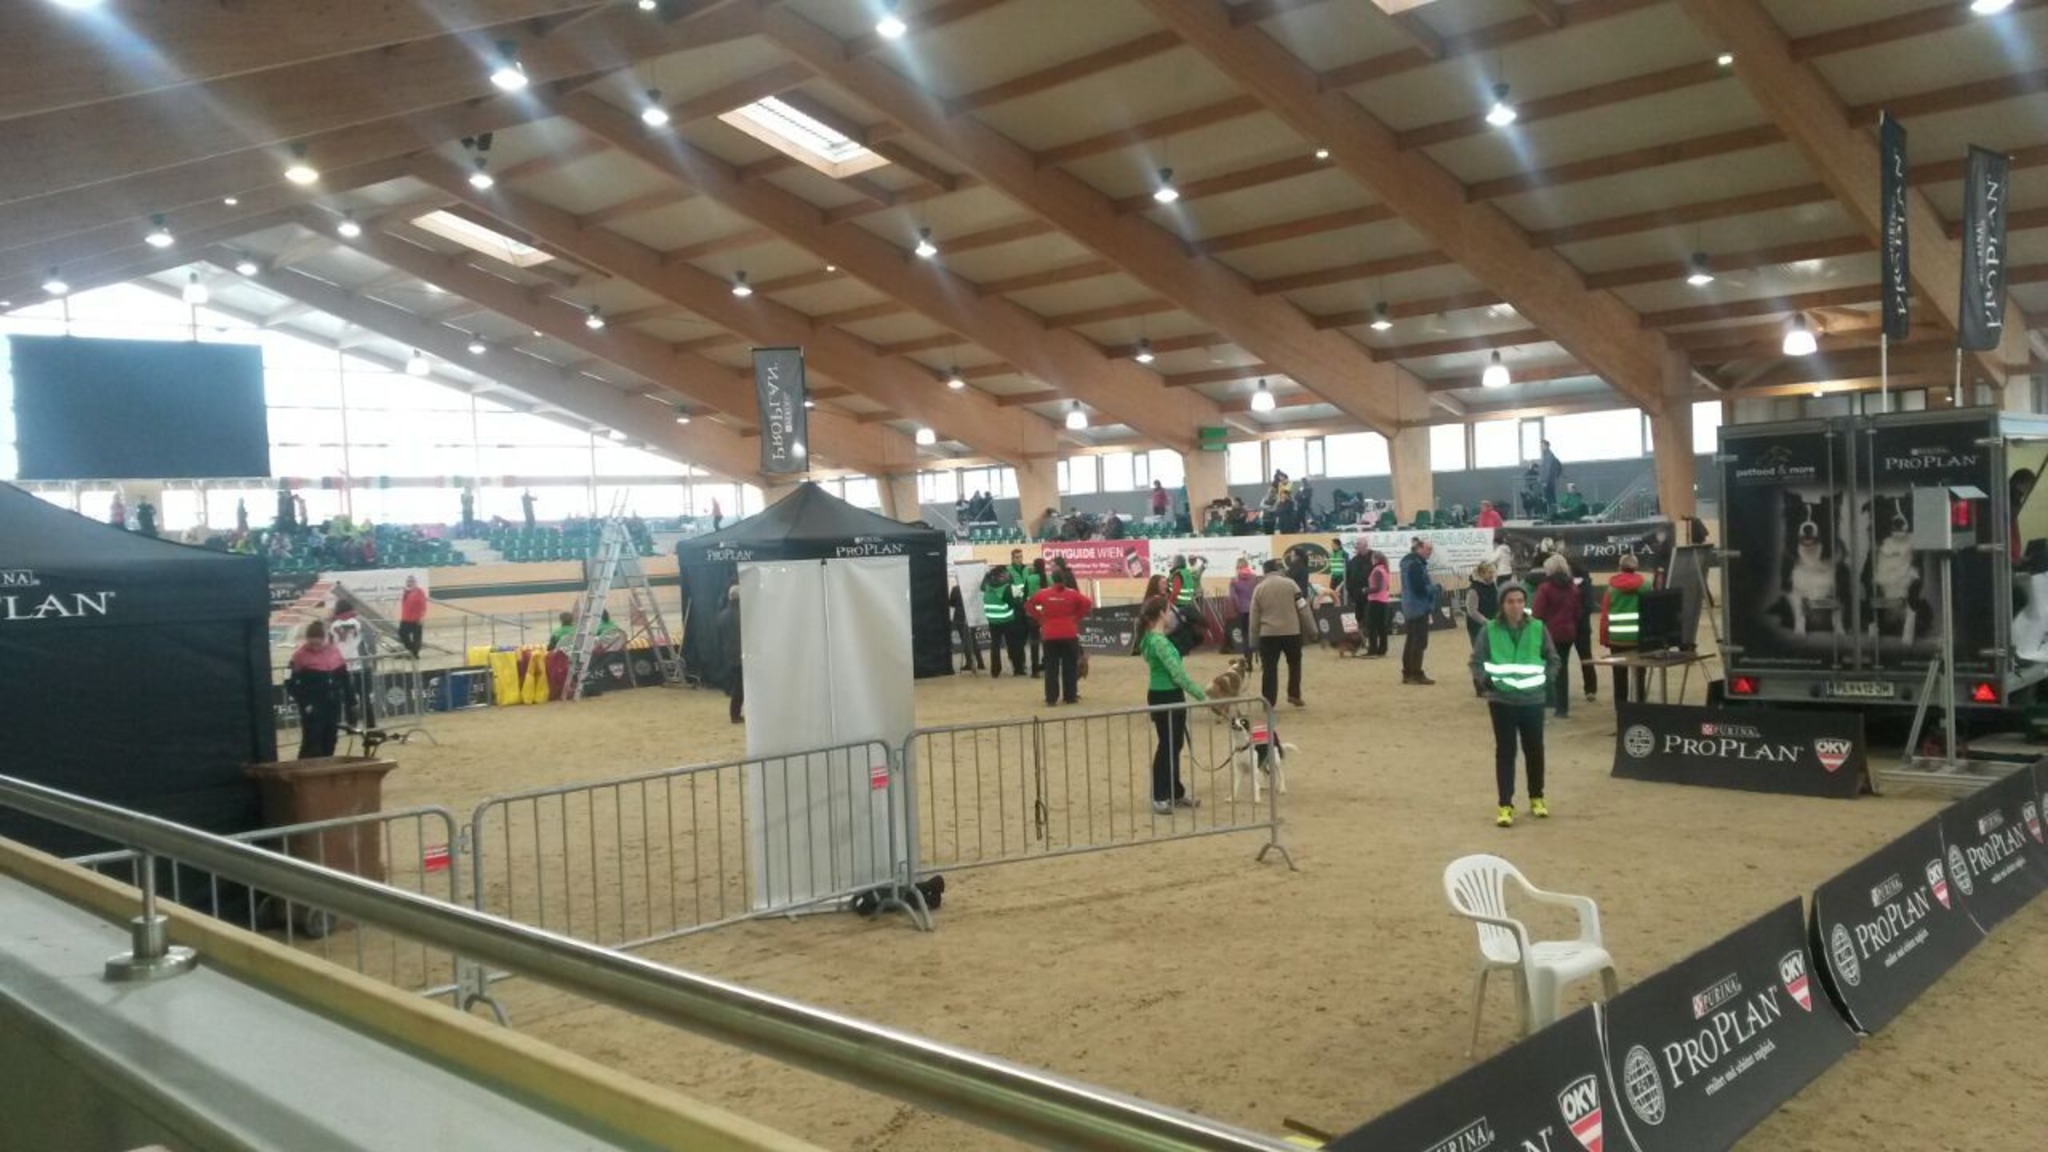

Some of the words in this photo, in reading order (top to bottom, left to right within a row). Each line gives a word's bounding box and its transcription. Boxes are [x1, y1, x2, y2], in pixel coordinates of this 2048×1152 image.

[1789, 465, 1815, 475] more
[1885, 454, 1977, 471] PROPLAN
[836, 543, 904, 557] PROPLAN
[1043, 547, 1096, 561] CITYGUIDE
[1097, 547, 1124, 558] WIEN
[1715, 724, 1757, 737] PURINA
[1663, 735, 1801, 763] PROPLAN
[1966, 823, 2027, 875] PROPLAN
[1855, 886, 1931, 960] PROPLAN
[1663, 985, 1781, 1088] PROPLAN
